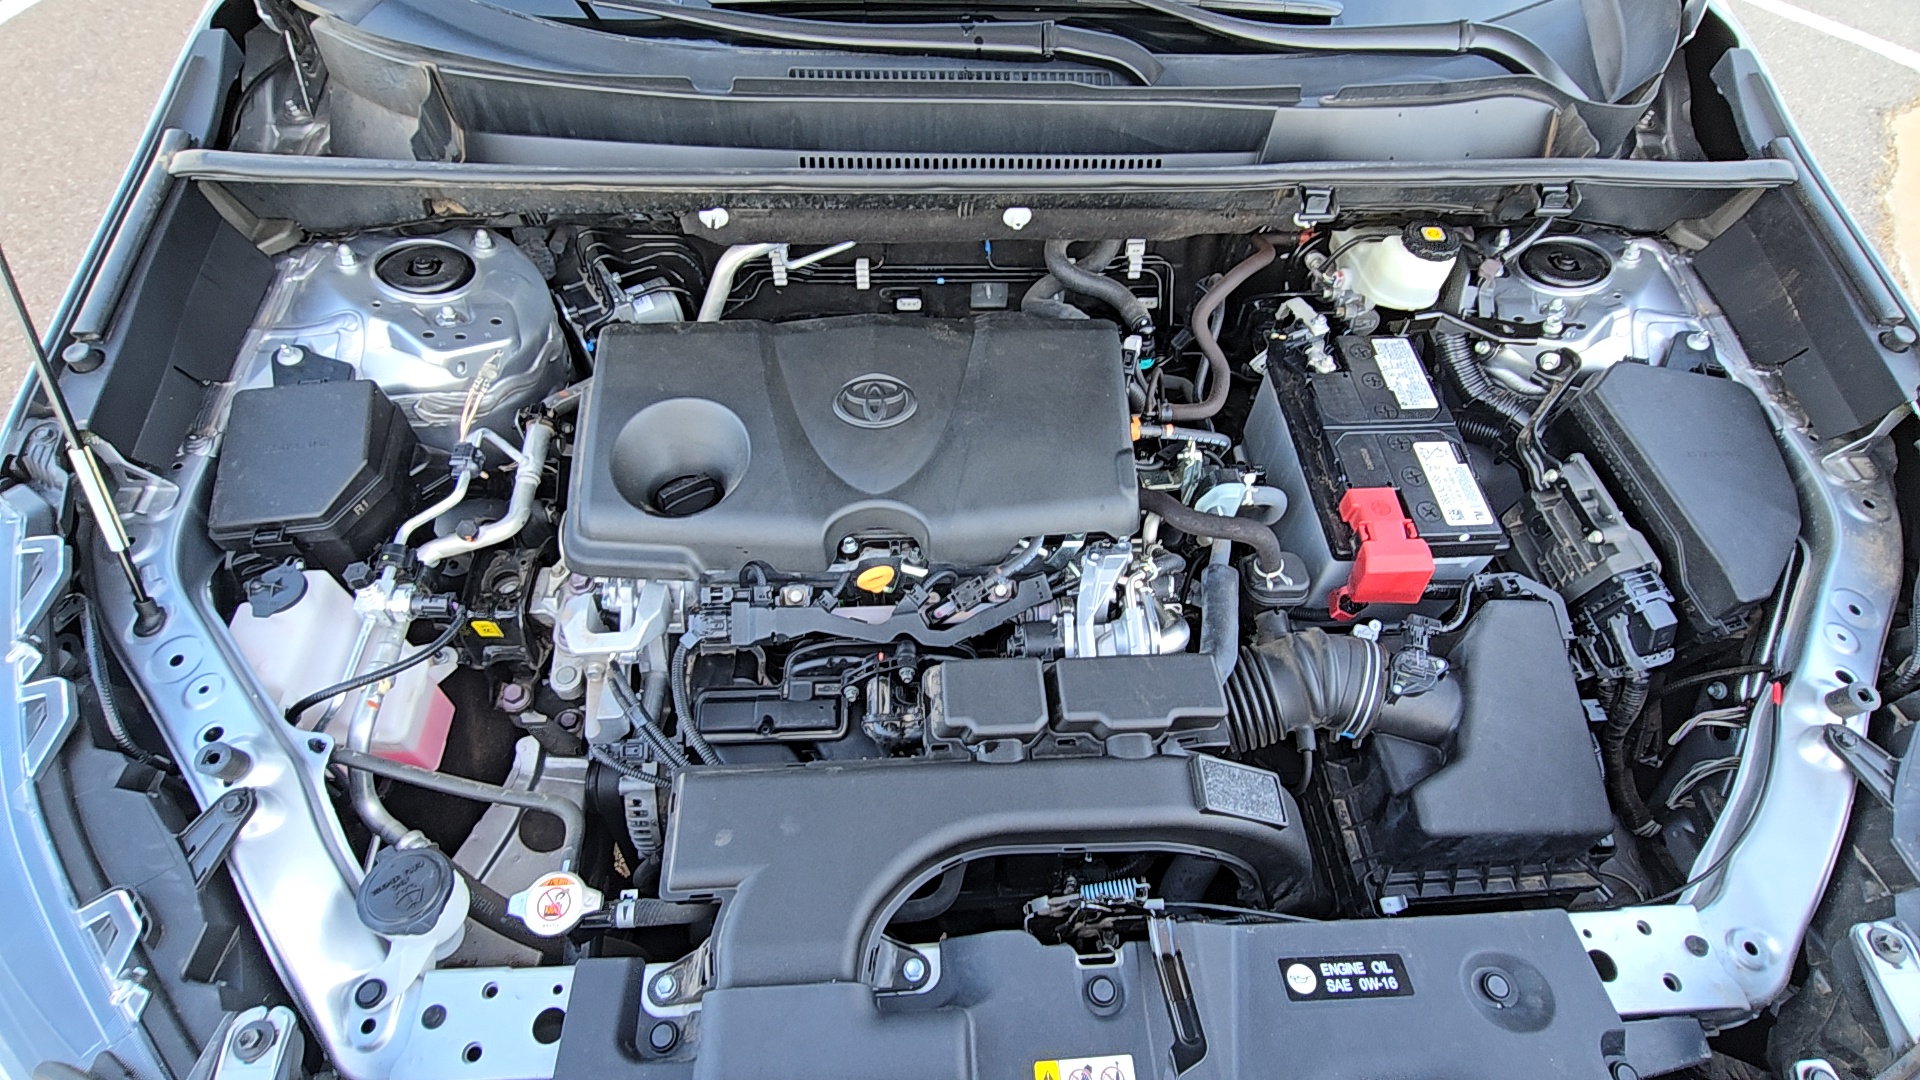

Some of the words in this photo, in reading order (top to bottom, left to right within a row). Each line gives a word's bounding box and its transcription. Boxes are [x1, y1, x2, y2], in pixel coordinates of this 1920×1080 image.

[353, 499, 369, 516] R1
[1320, 962, 1366, 976] ENGINE
[1371, 961, 1393, 974] OIL
[1326, 979, 1353, 992] SAE
[1359, 977, 1398, 991] 0W-16
